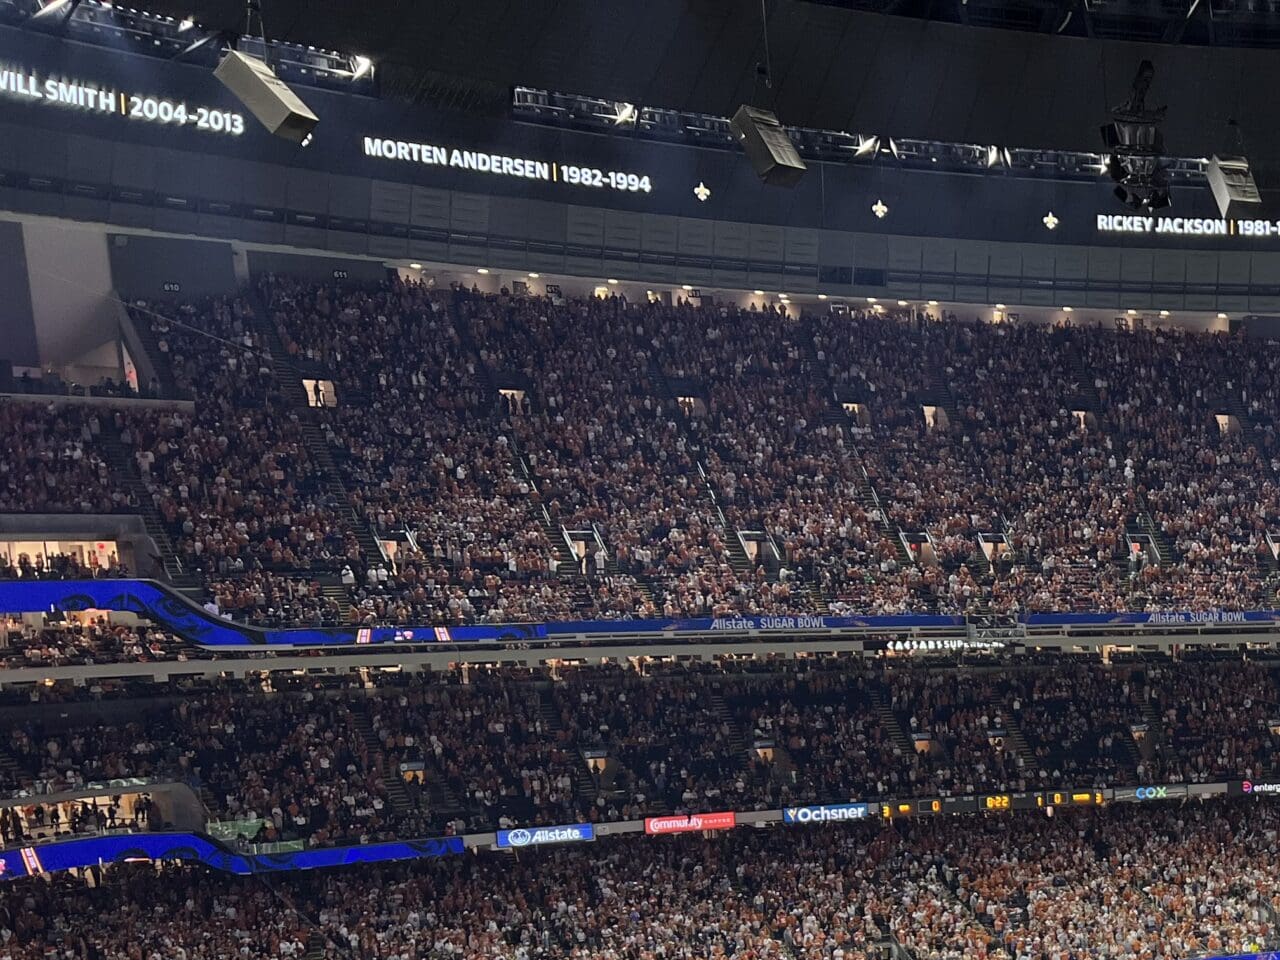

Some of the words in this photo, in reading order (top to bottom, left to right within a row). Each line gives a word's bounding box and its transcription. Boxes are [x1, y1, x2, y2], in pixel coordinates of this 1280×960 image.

[44, 79, 116, 112] SMITH
[129, 96, 244, 136] 2004-2013
[363, 136, 447, 166] MORTEN
[449, 149, 549, 181] ANDERSEN
[560, 164, 651, 193] 1982-1994
[1096, 213, 1152, 232] RICKEY
[1155, 216, 1227, 235] JACKSON
[710, 617, 755, 630] Allstate
[759, 617, 795, 629] SUGAR
[797, 616, 827, 628] BOWL
[1147, 612, 1186, 624] Allstate
[1189, 612, 1220, 623] SUGAR
[1221, 610, 1247, 622] BOWL
[886, 640, 943, 650] CAESARS
[1054, 793, 1061, 804] 0
[1135, 785, 1167, 799] COX
[931, 800, 940, 811] 0
[986, 796, 1009, 808] 8:22
[797, 805, 865, 822] Ochsner
[531, 828, 580, 842] Allstate
